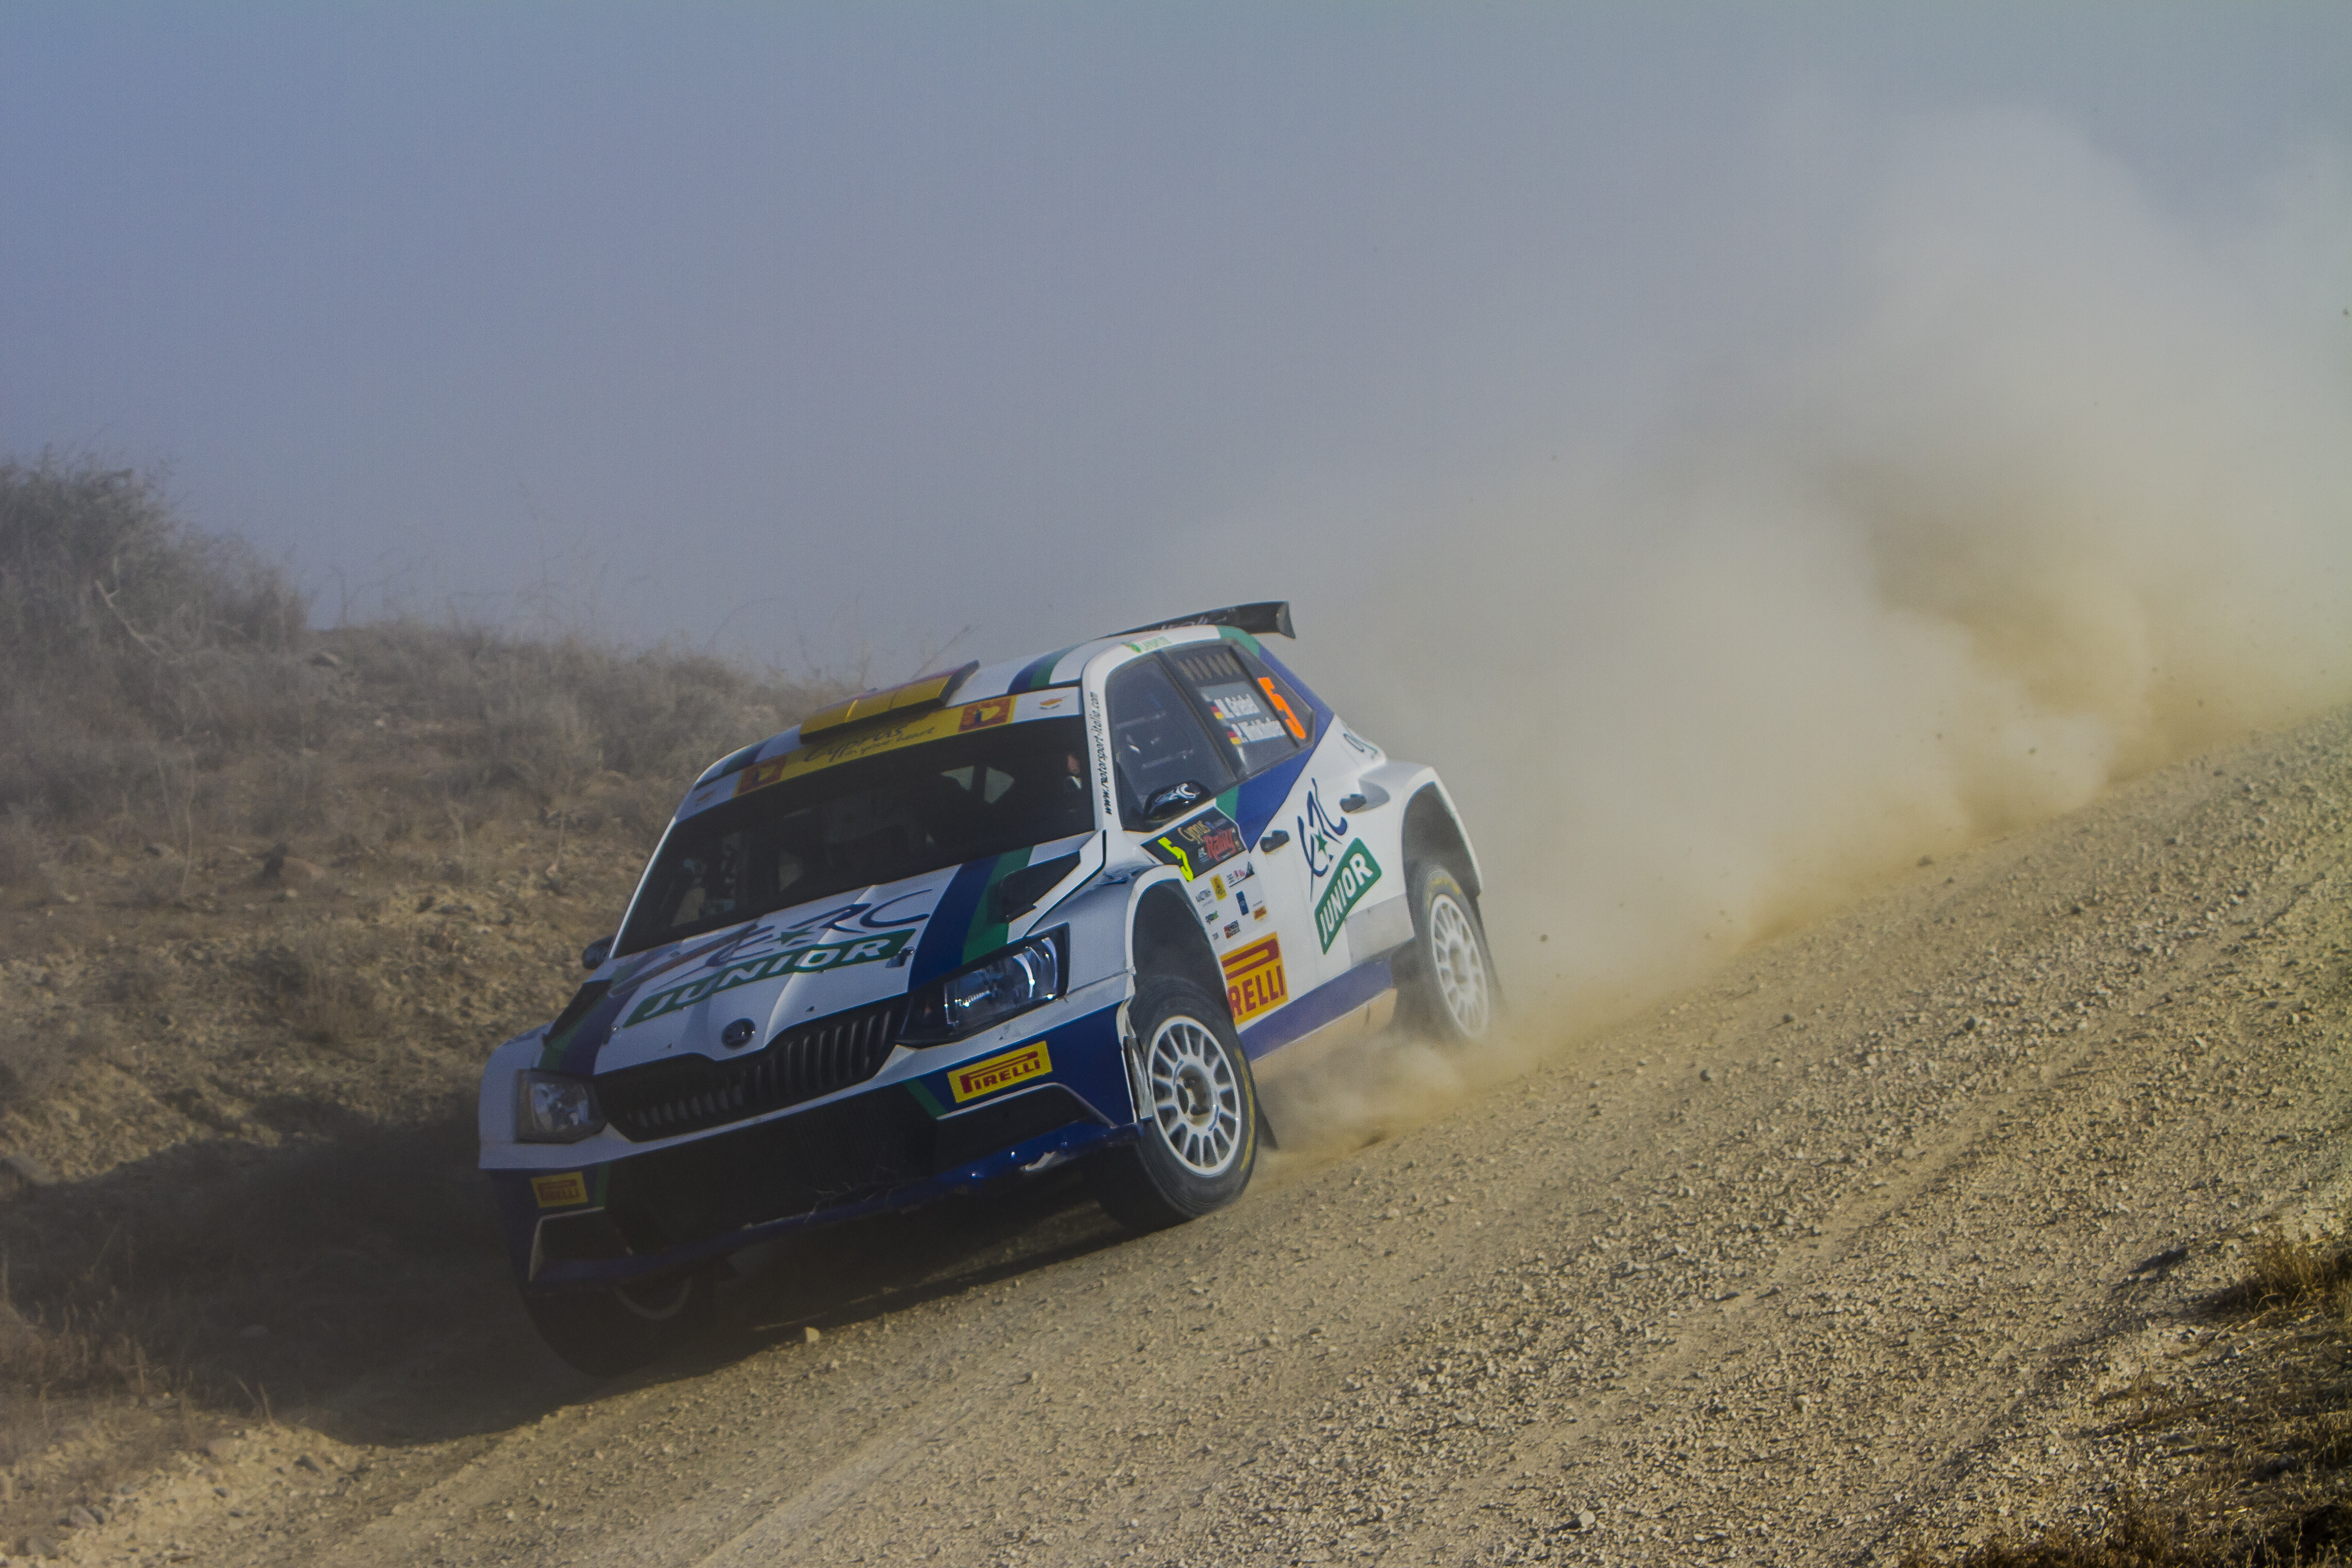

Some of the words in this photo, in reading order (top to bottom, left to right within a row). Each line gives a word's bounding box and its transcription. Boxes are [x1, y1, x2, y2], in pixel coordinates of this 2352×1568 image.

[1257, 677, 1306, 740] 5
[1157, 836, 1194, 882] 5
[1177, 820, 1211, 845] Cyprus
[1318, 852, 1374, 942] JUNIOR
[643, 938, 892, 1018] JUNIOR
[959, 1051, 1041, 1094] PIRELLI
